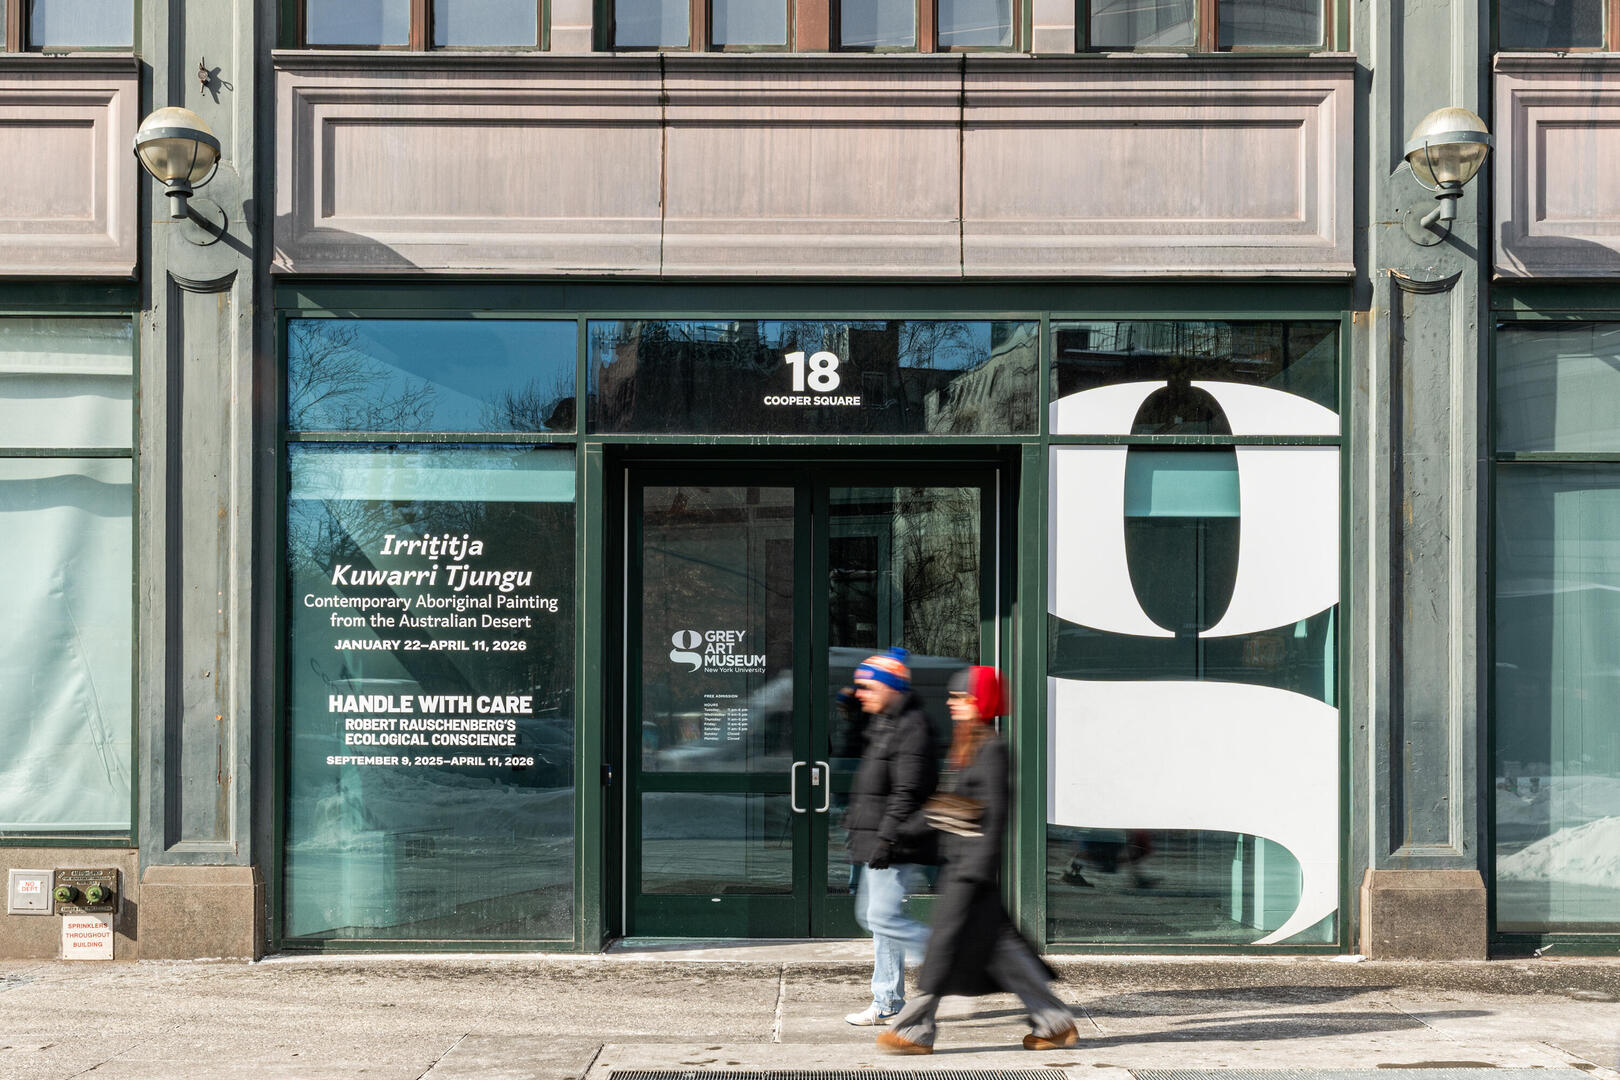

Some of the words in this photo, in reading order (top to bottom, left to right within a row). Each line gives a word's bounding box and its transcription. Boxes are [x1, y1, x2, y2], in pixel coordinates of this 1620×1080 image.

[784, 351, 841, 392] 18
[764, 396, 812, 406] COOPER
[813, 396, 861, 406] SQUARE
[331, 564, 439, 586] Kuwarri
[446, 564, 533, 592] Tjungu
[304, 594, 412, 611] Contemporary
[415, 594, 492, 611] Aboriginal
[496, 595, 559, 612] Painting
[330, 613, 366, 628] from
[370, 613, 395, 628] the
[399, 614, 477, 628] Australian
[481, 614, 532, 628] Desert
[704, 630, 746, 643] GREY
[334, 640, 402, 651] JANUARY
[403, 640, 470, 651] 22–APRIL
[472, 641, 490, 652] 11,
[492, 641, 527, 651] 2026
[704, 643, 736, 654] ART
[704, 654, 766, 667] MUSEUM
[328, 695, 414, 713] HANDLE
[417, 696, 473, 713] WITH
[476, 696, 533, 713] CARE
[345, 719, 398, 731] ROBERT
[399, 719, 517, 731] RAUSCHENBERG’S
[345, 733, 429, 746] ECOLOGICAL
[431, 734, 517, 746] CONSCIENCE
[326, 756, 400, 766] SEPTEMBER
[401, 757, 412, 767] 9,
[414, 756, 486, 766] 2025–APRIL
[487, 757, 503, 767] 11,
[504, 757, 534, 766] 2026
